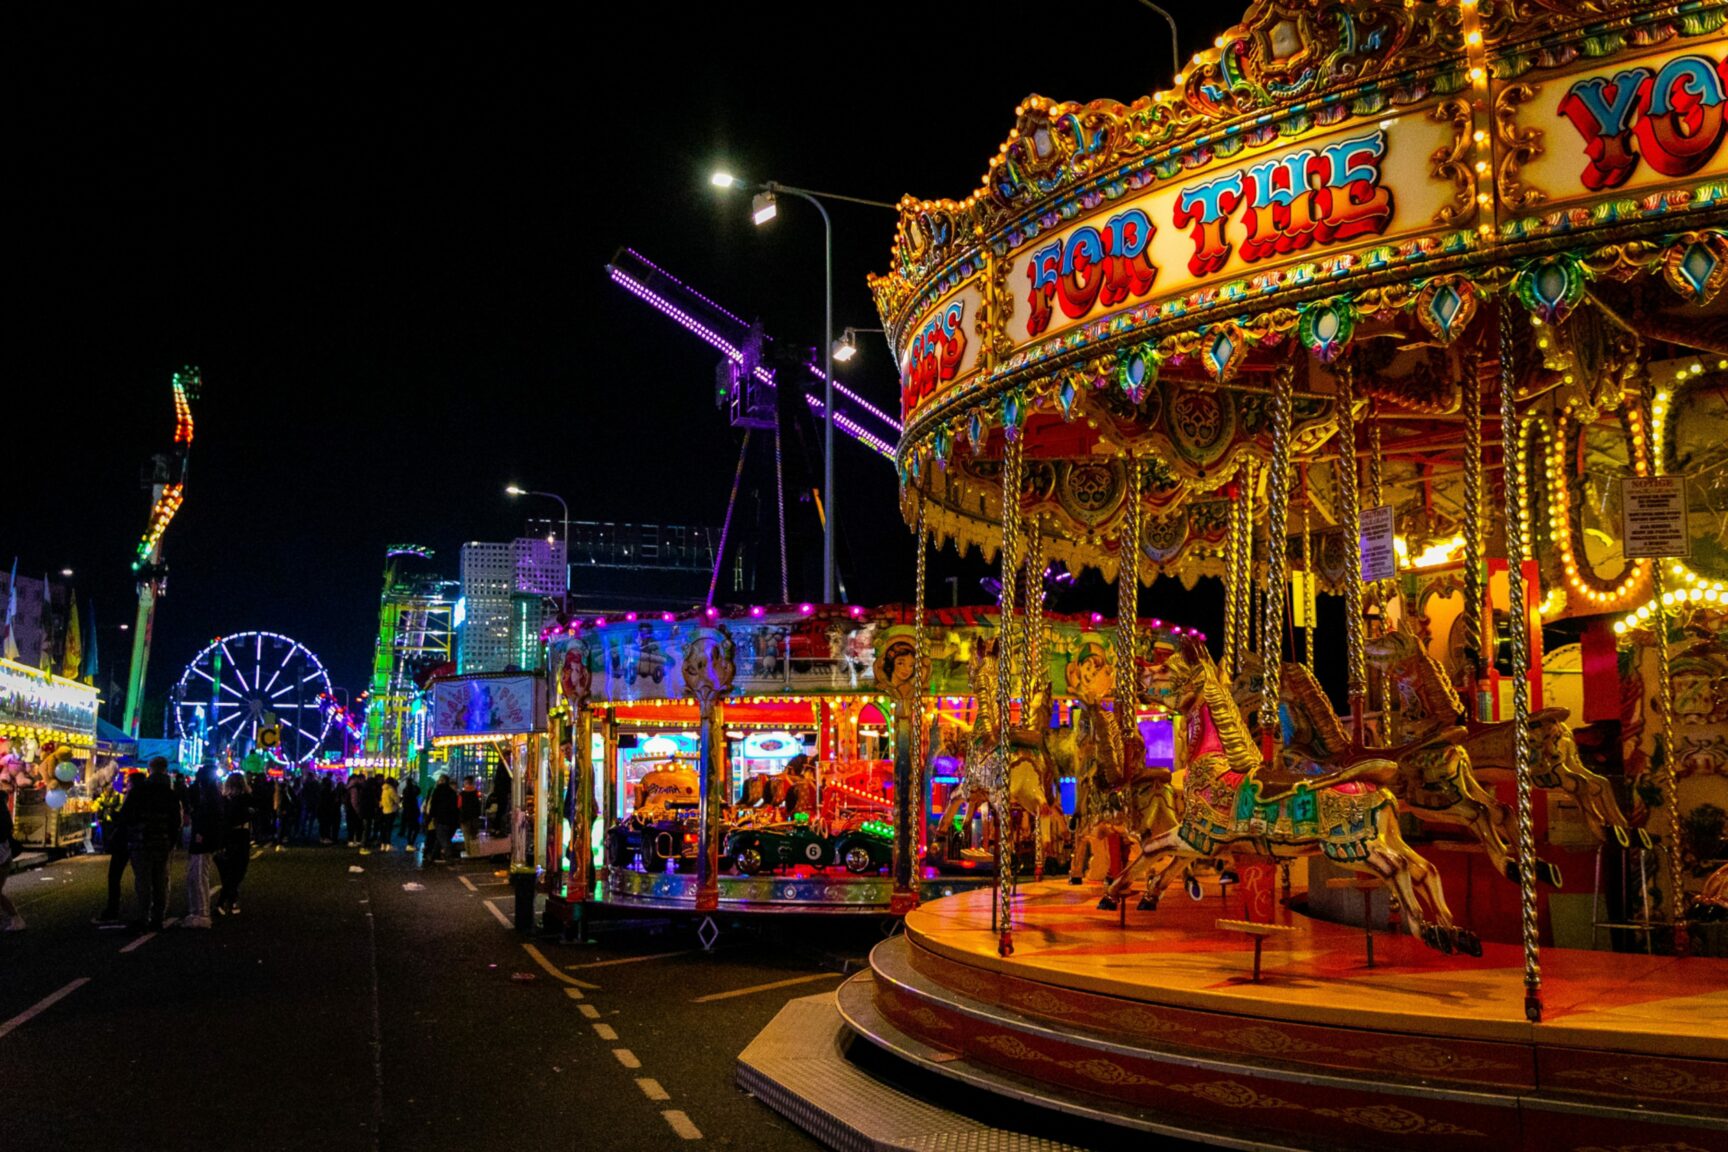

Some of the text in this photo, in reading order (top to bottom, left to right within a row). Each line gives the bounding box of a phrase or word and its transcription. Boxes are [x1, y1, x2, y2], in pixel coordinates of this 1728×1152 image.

[1027, 208, 1158, 336] FOR
[1173, 129, 1393, 277] THE
[1557, 54, 1728, 192] YO
[261, 728, 276, 747] C
[810, 846, 817, 856] 6
